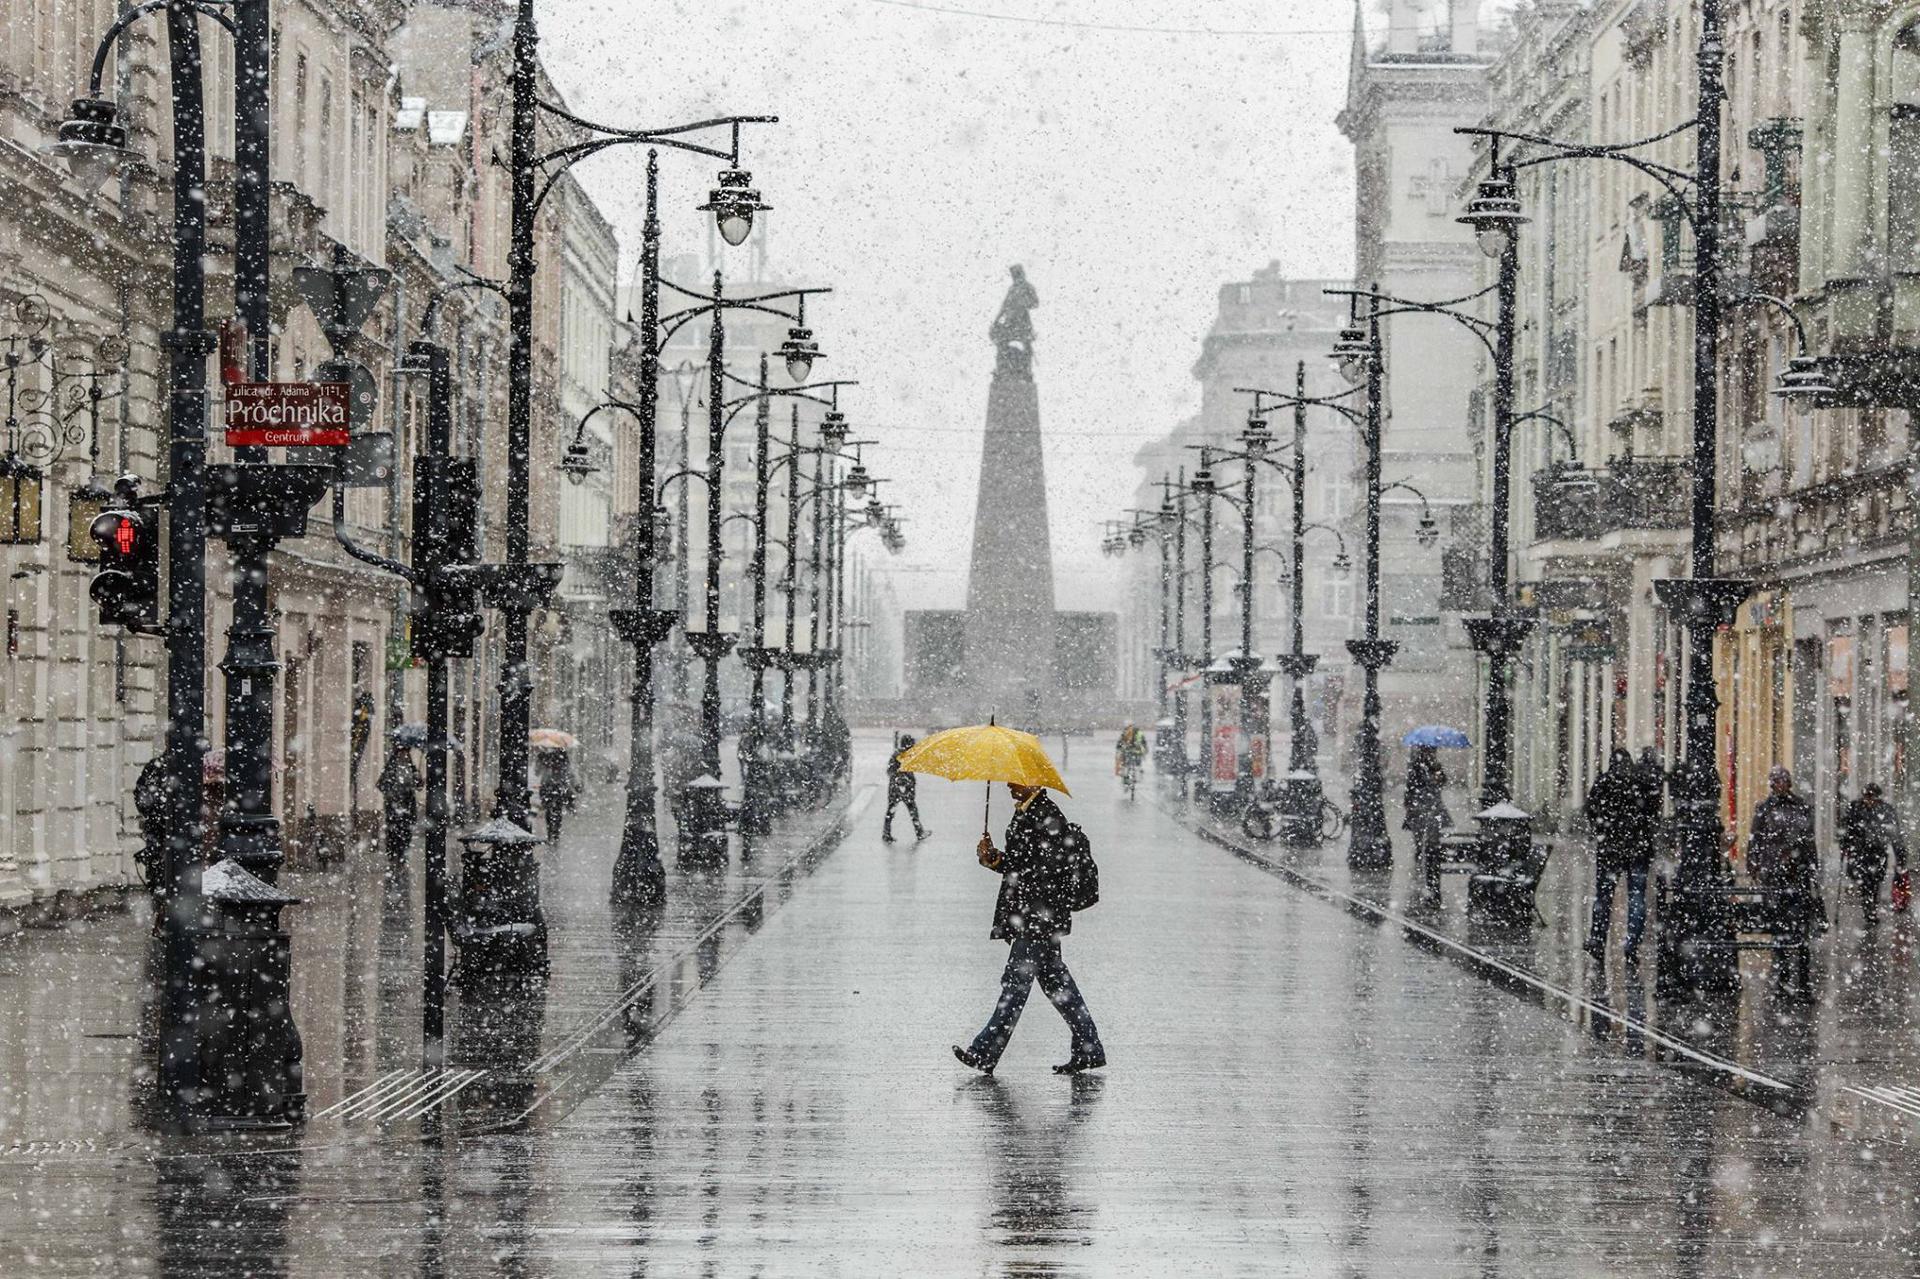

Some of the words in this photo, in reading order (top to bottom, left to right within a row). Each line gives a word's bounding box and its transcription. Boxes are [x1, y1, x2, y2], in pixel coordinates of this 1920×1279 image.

[234, 385, 257, 396] ulica
[264, 385, 277, 396] dr.
[280, 386, 310, 396] Adama
[229, 397, 345, 423] Próchnika
[265, 431, 310, 442] Centrum
